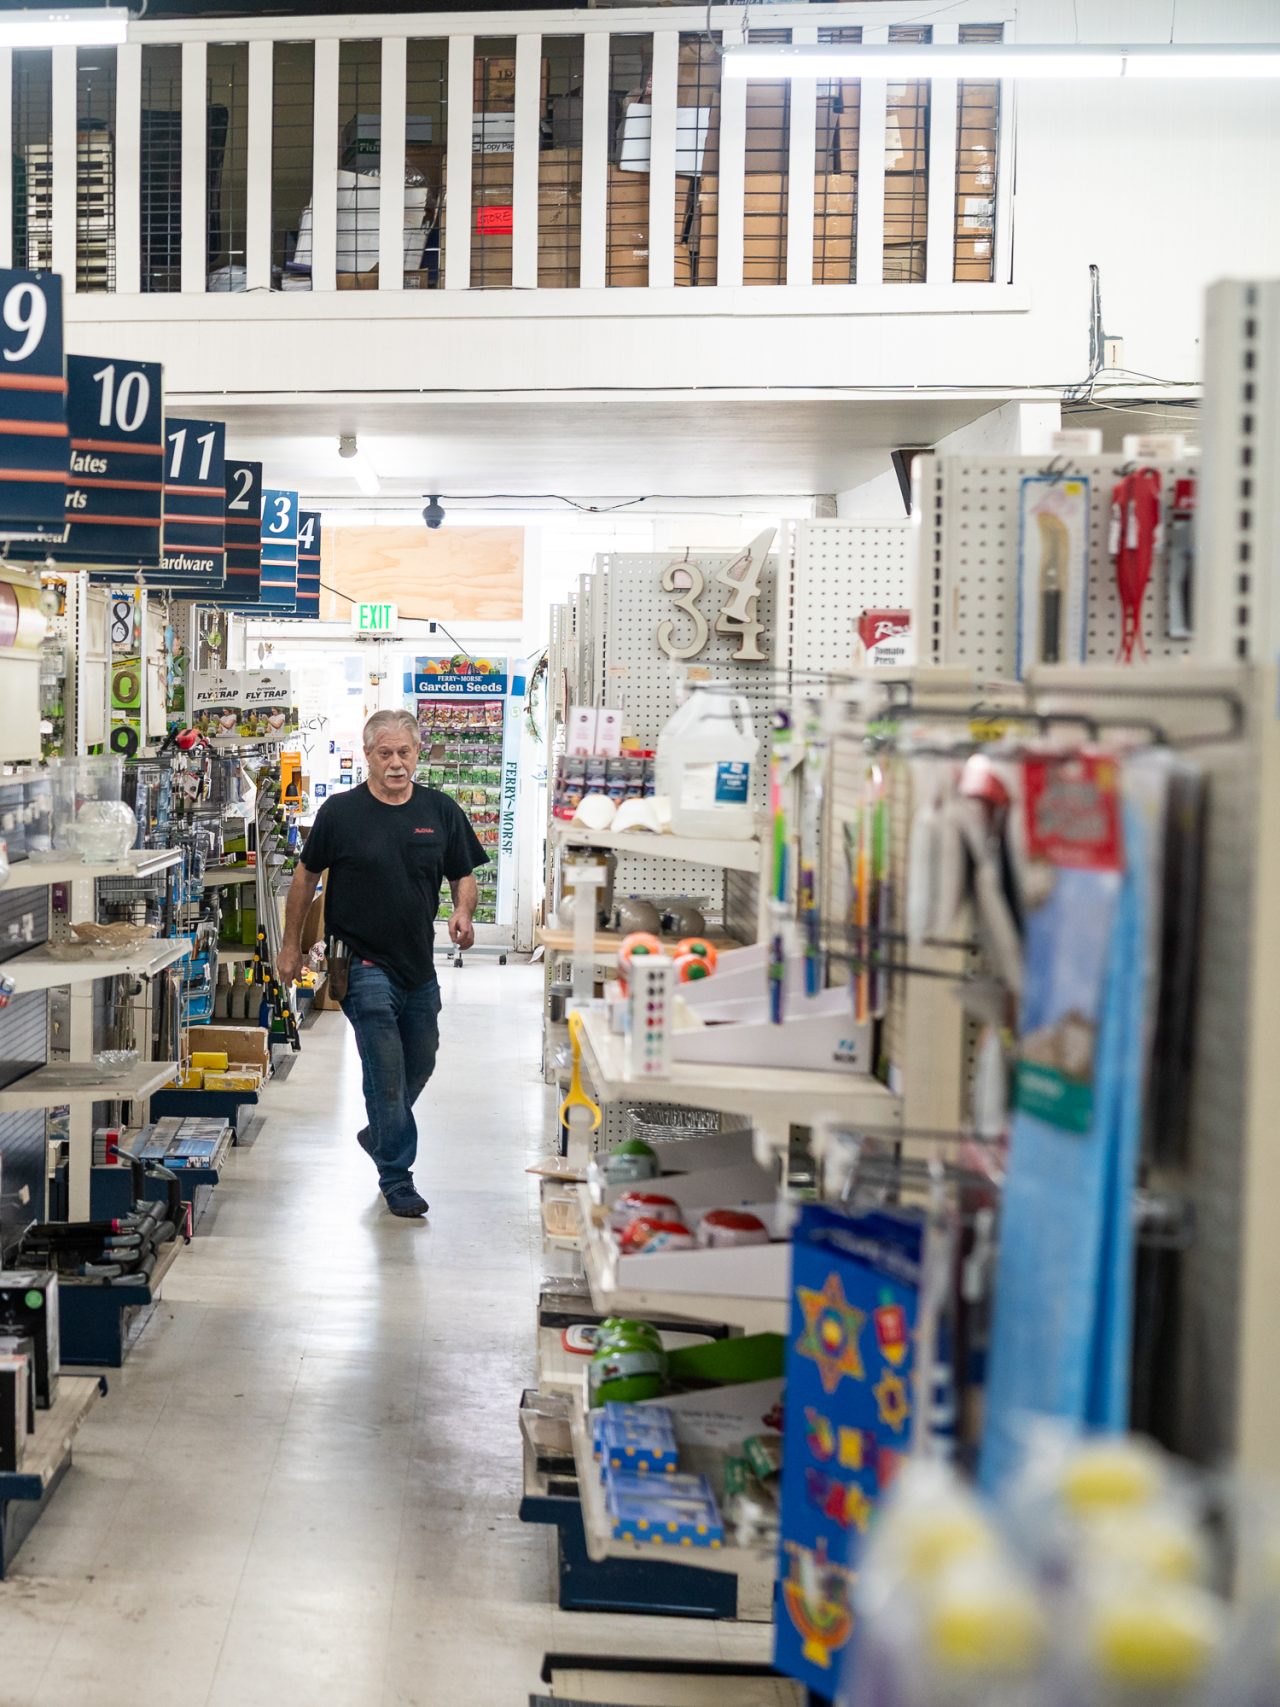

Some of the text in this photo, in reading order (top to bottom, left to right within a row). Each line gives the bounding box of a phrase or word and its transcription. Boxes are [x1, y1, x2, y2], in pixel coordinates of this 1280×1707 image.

[2, 281, 48, 363] 9
[93, 364, 150, 432] 10
[168, 428, 217, 481] 11
[160, 554, 215, 573] ardware
[359, 604, 392, 630] EXIT
[874, 647, 905, 656] Tomato
[197, 692, 212, 700] FLY
[245, 692, 262, 700] FLY
[263, 689, 288, 698] TRAP
[419, 682, 502, 692] Garden Seeds
